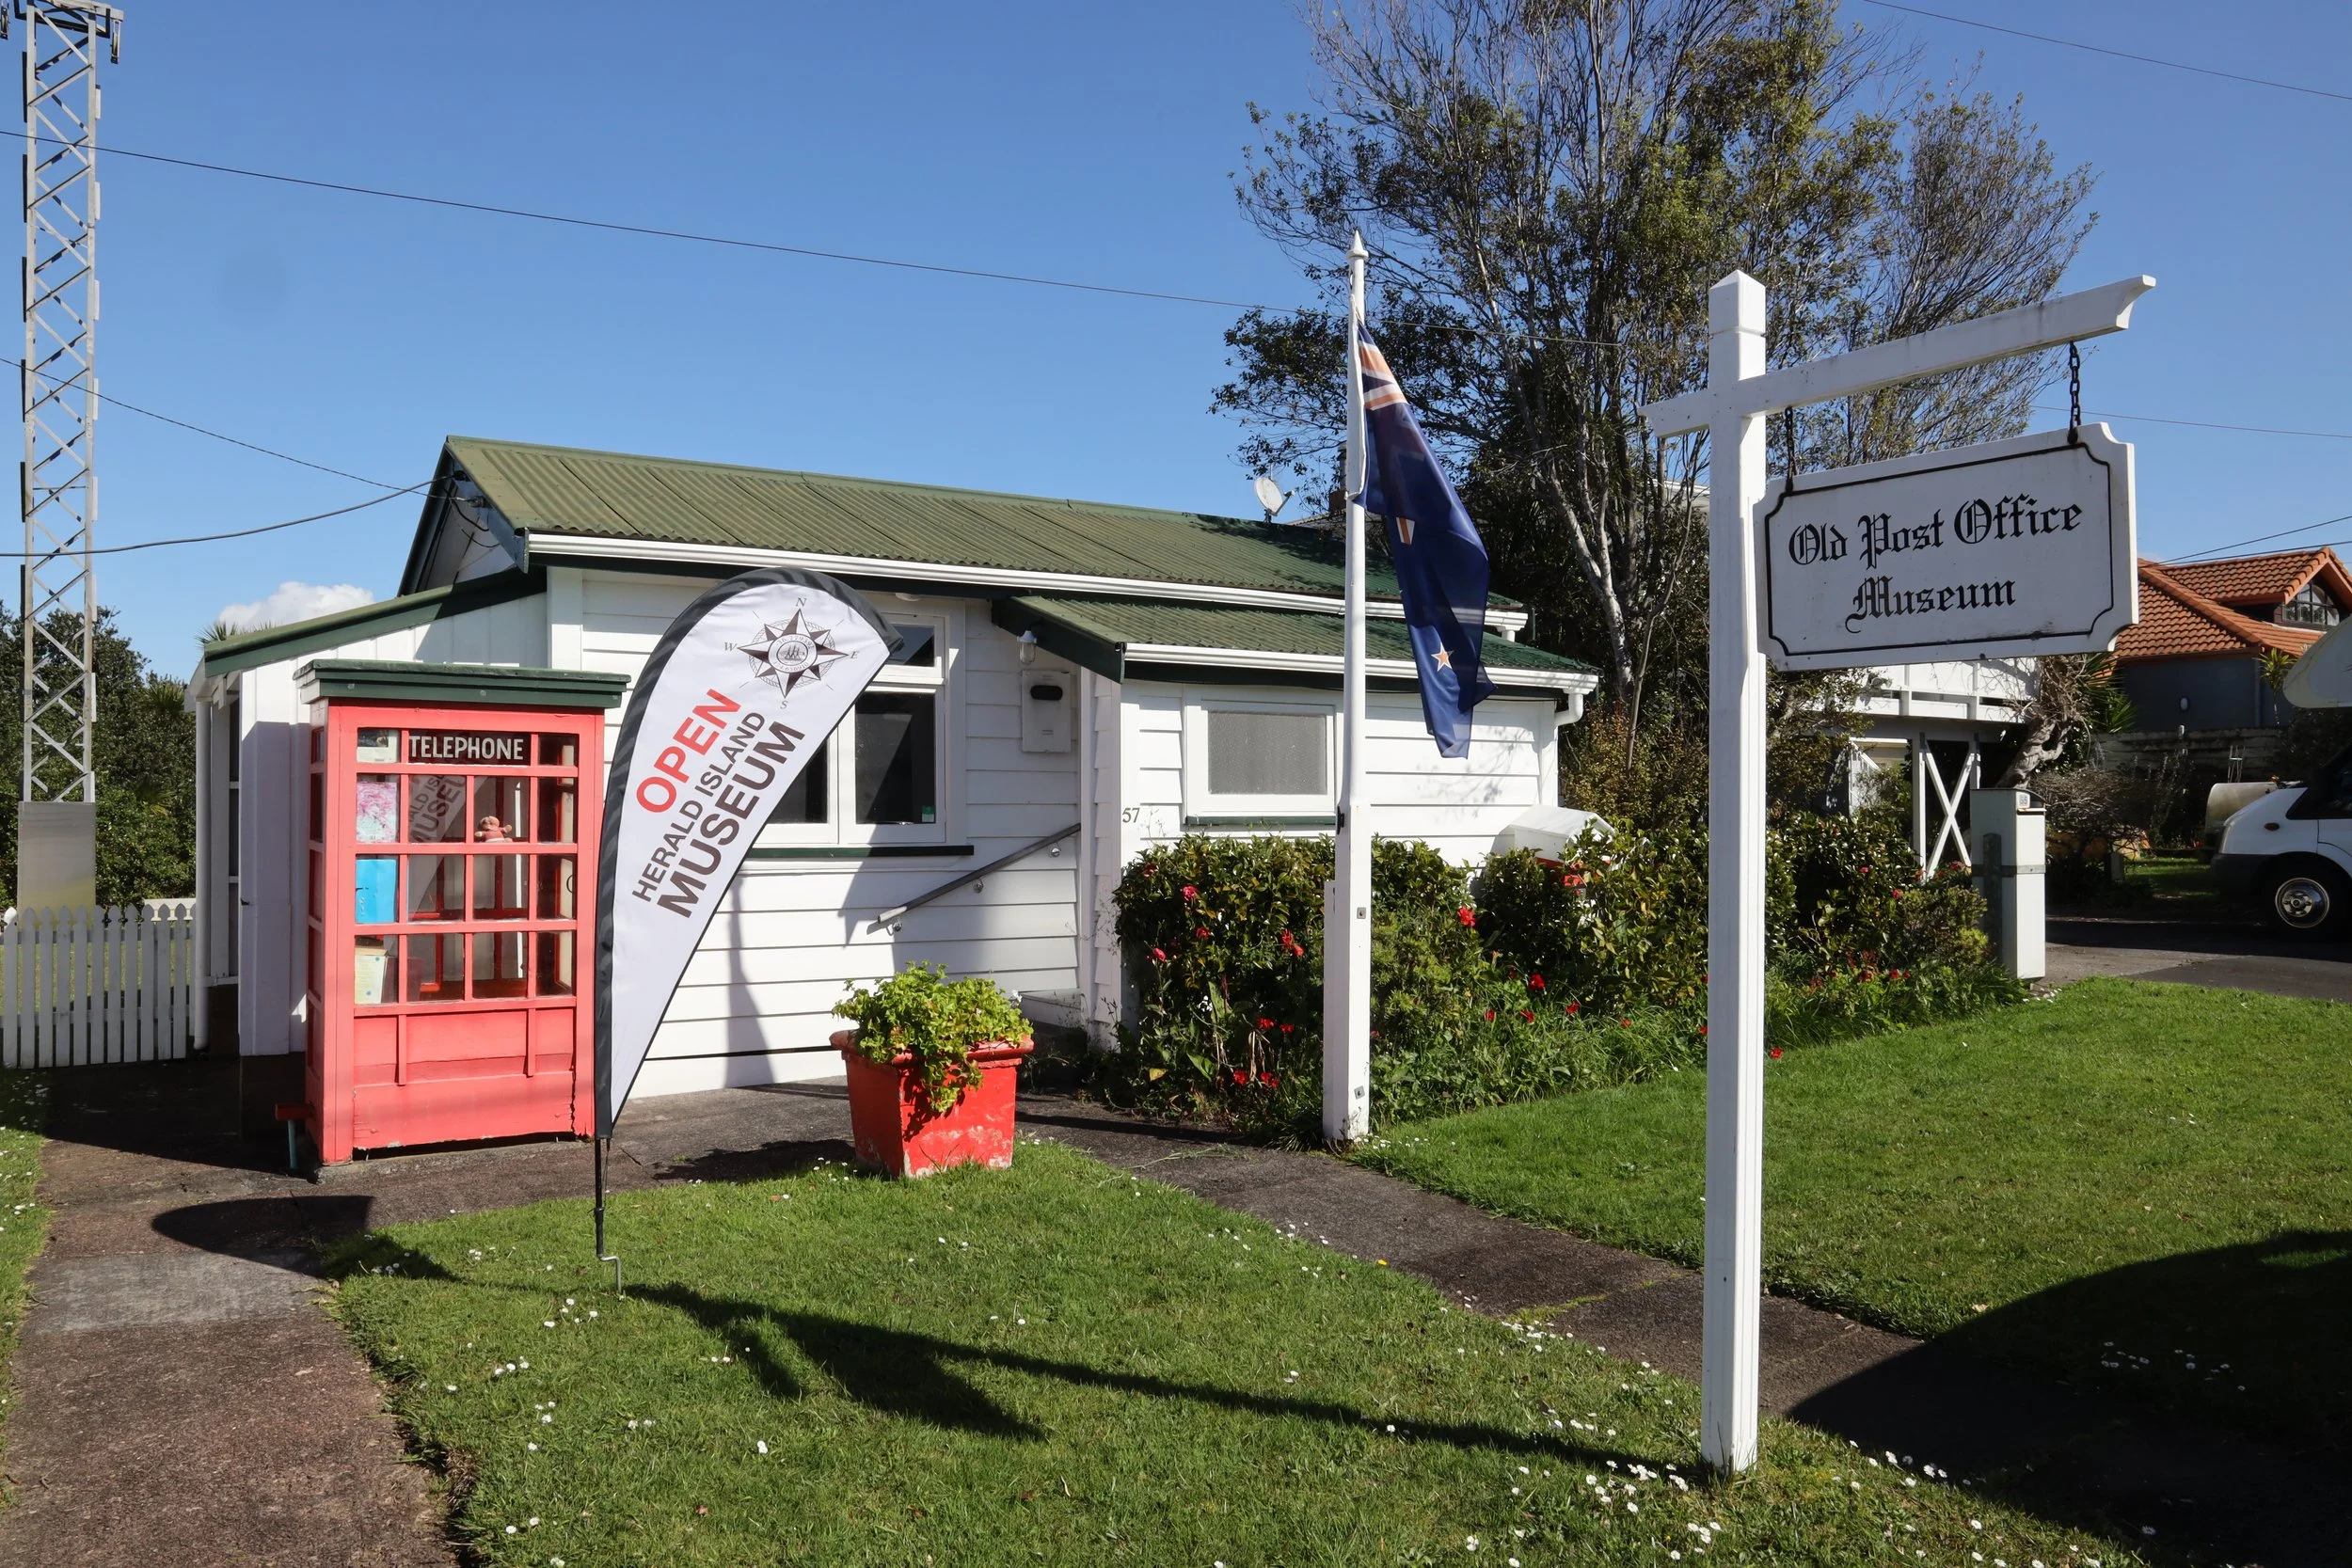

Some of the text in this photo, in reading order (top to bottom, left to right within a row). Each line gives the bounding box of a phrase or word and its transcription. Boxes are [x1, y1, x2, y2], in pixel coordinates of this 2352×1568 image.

[1788, 493, 2083, 571] Old Post Office
[796, 597, 806, 607] N
[1845, 575, 2016, 634] Museum
[724, 641, 738, 652] W
[780, 700, 788, 709] S
[408, 736, 524, 760] TELEPHONE
[636, 689, 741, 813] OPEN
[631, 712, 765, 902] HERALD ISLAND
[657, 721, 806, 918] MUSEUM
[1122, 807, 1140, 823] 57
